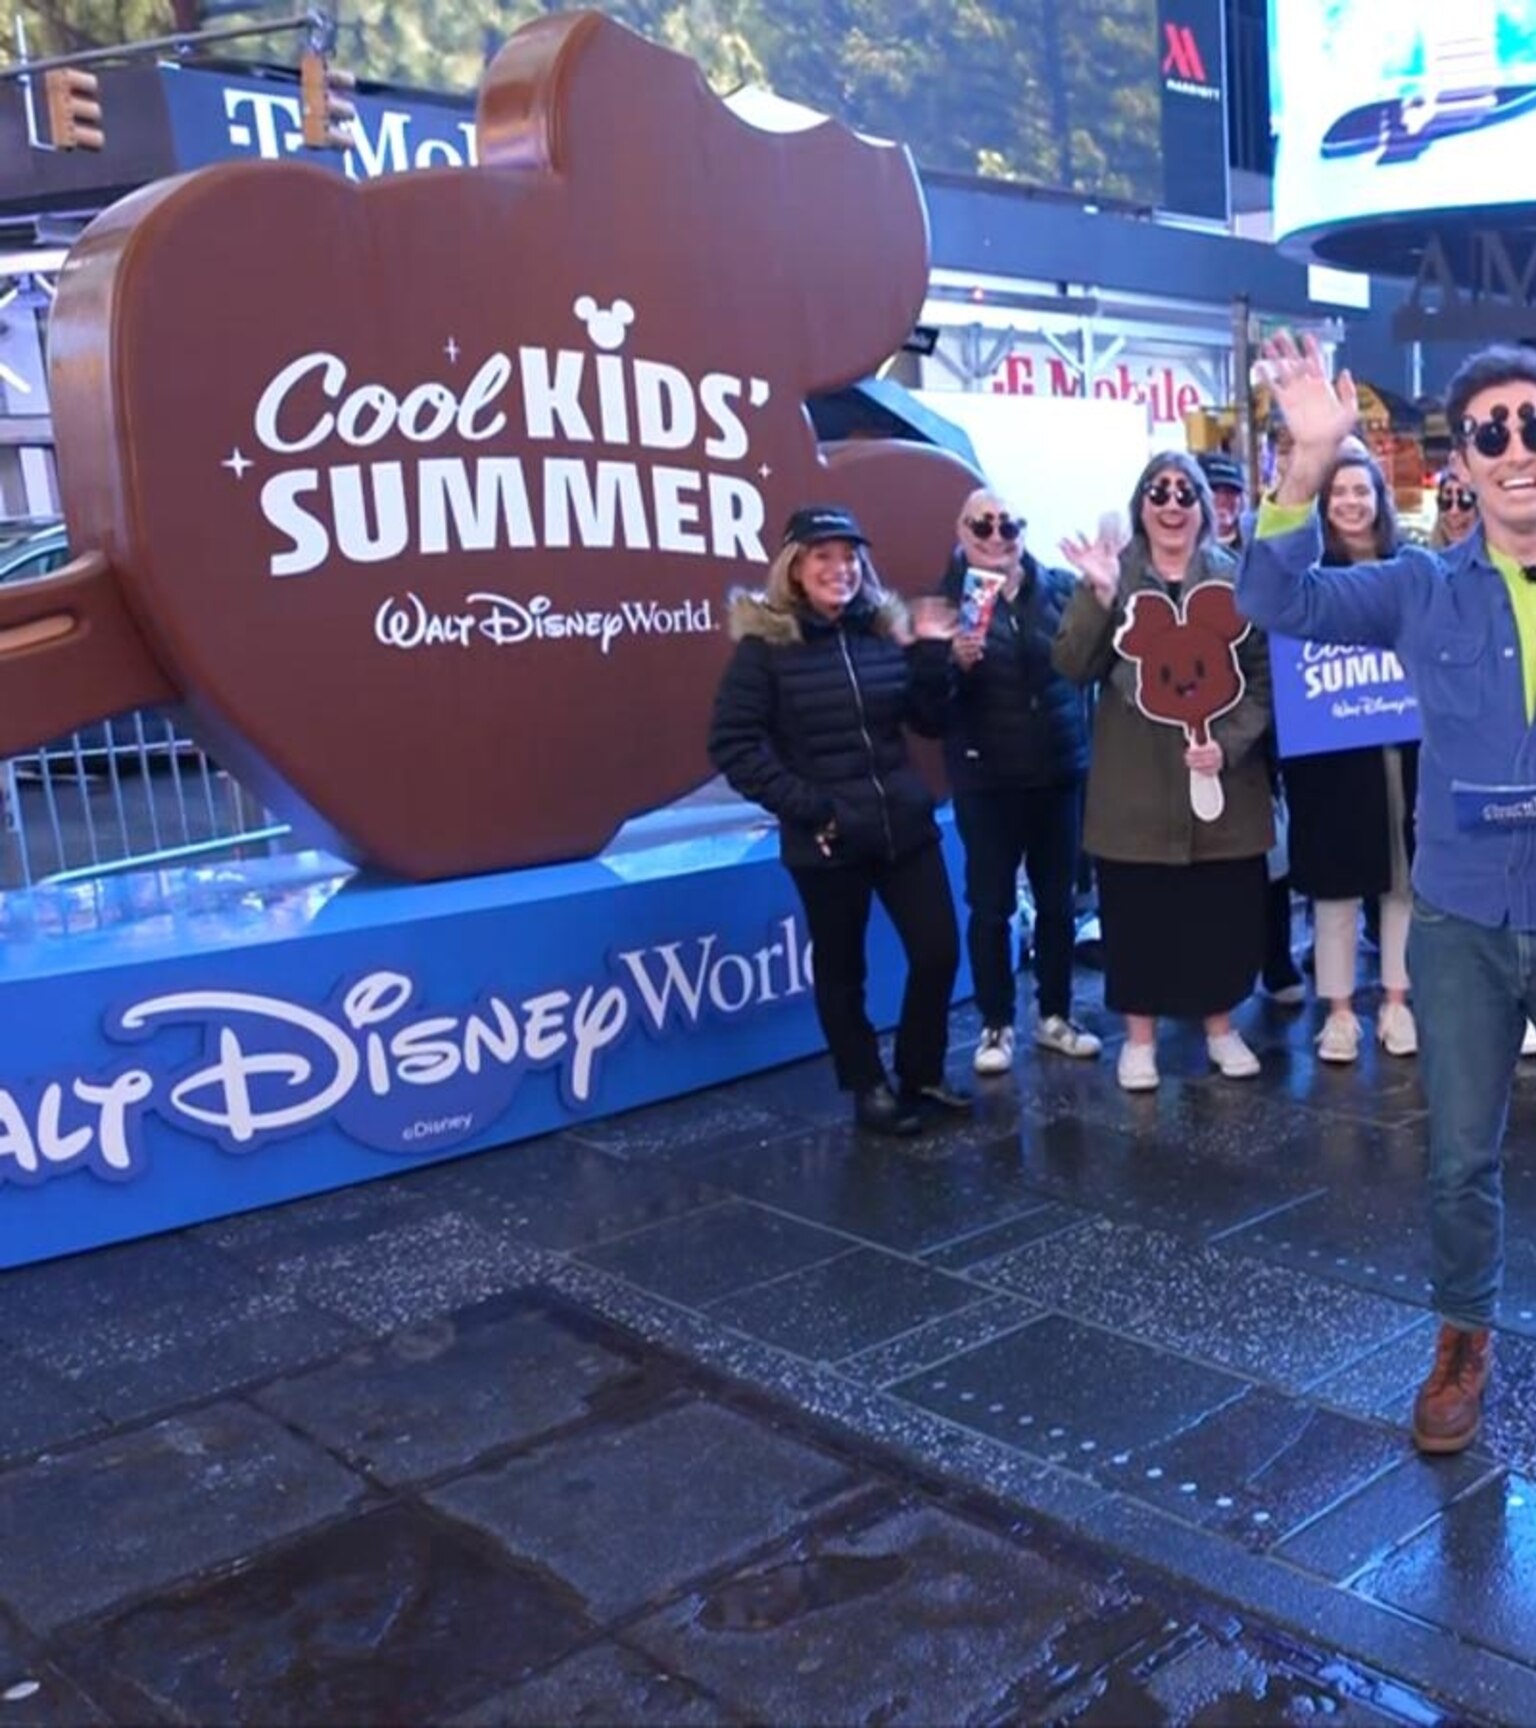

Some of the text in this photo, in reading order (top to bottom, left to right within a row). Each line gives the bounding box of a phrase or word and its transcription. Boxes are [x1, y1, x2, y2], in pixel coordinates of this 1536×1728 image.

[255, 351, 512, 454] Cool
[260, 457, 769, 577] SUMMER
[620, 598, 713, 634] World
